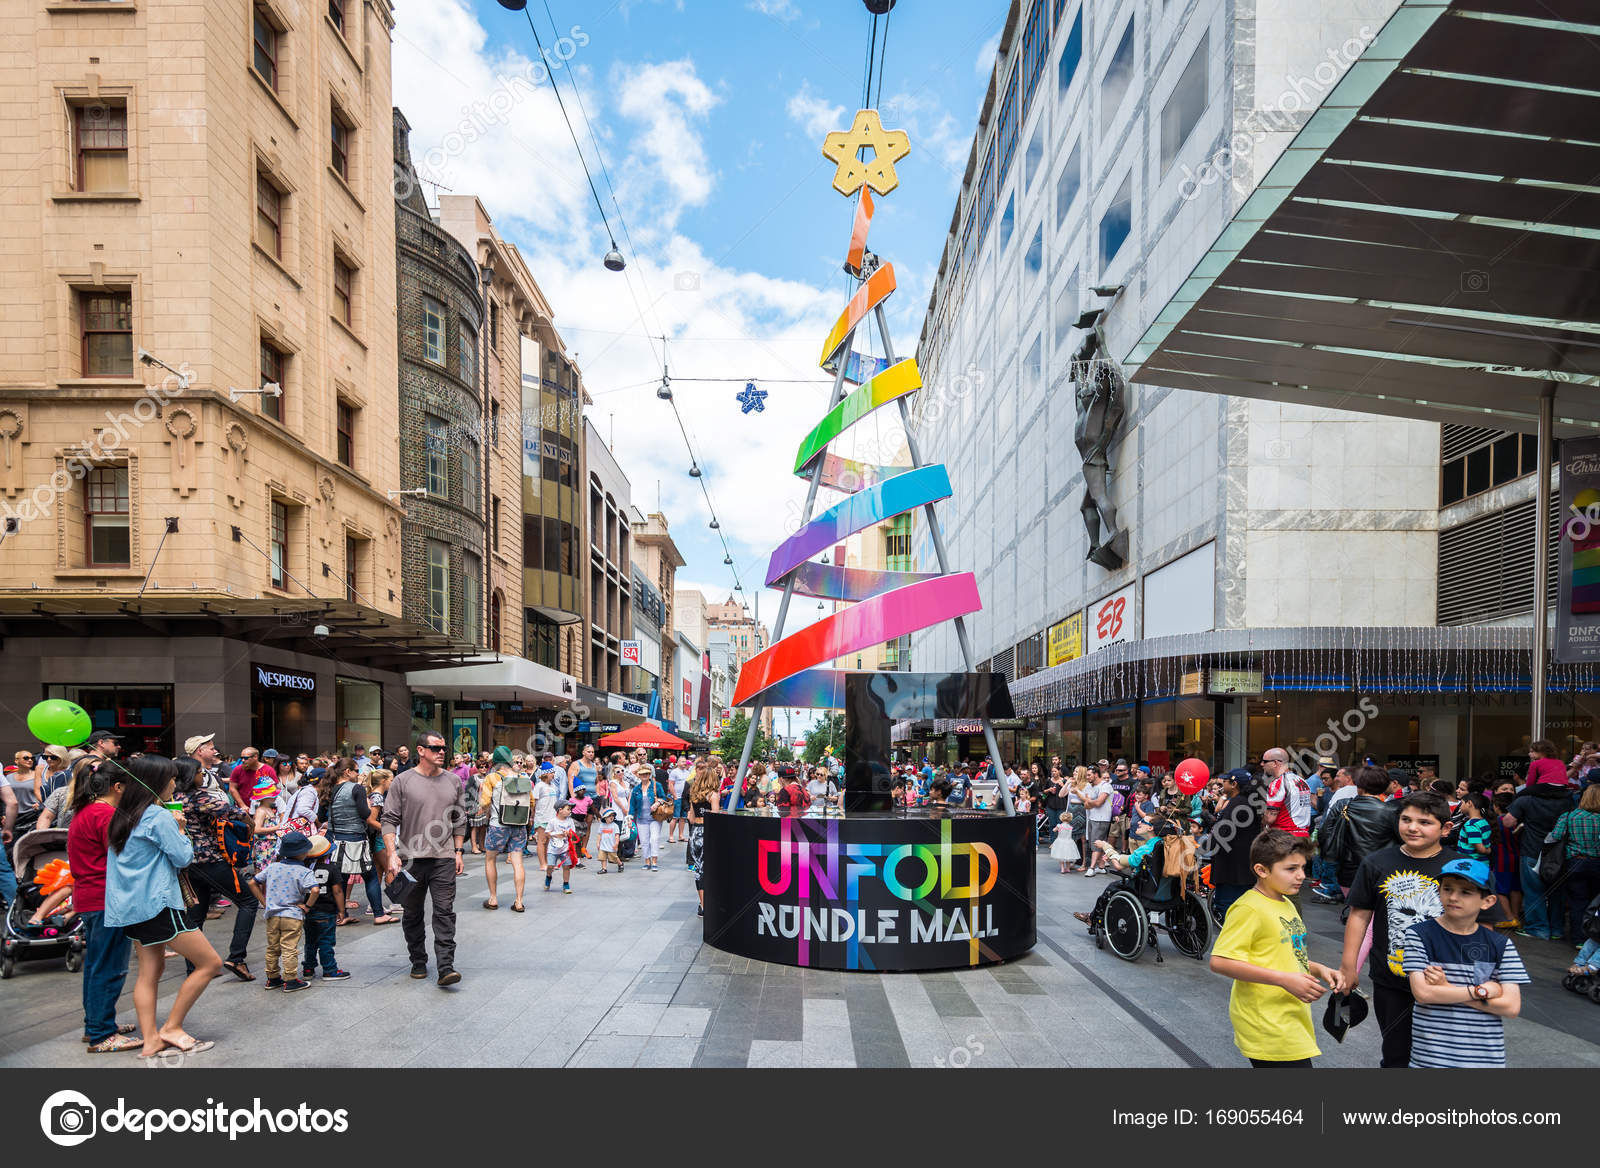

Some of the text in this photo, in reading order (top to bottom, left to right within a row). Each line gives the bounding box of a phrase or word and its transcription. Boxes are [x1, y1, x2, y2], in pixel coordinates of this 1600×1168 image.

[1096, 596, 1126, 640] EB
[624, 648, 638, 658] SA
[257, 667, 315, 692] NESPRESSO
[758, 840, 999, 901] UNFOLD
[758, 902, 999, 944] RUNDLE MALL
